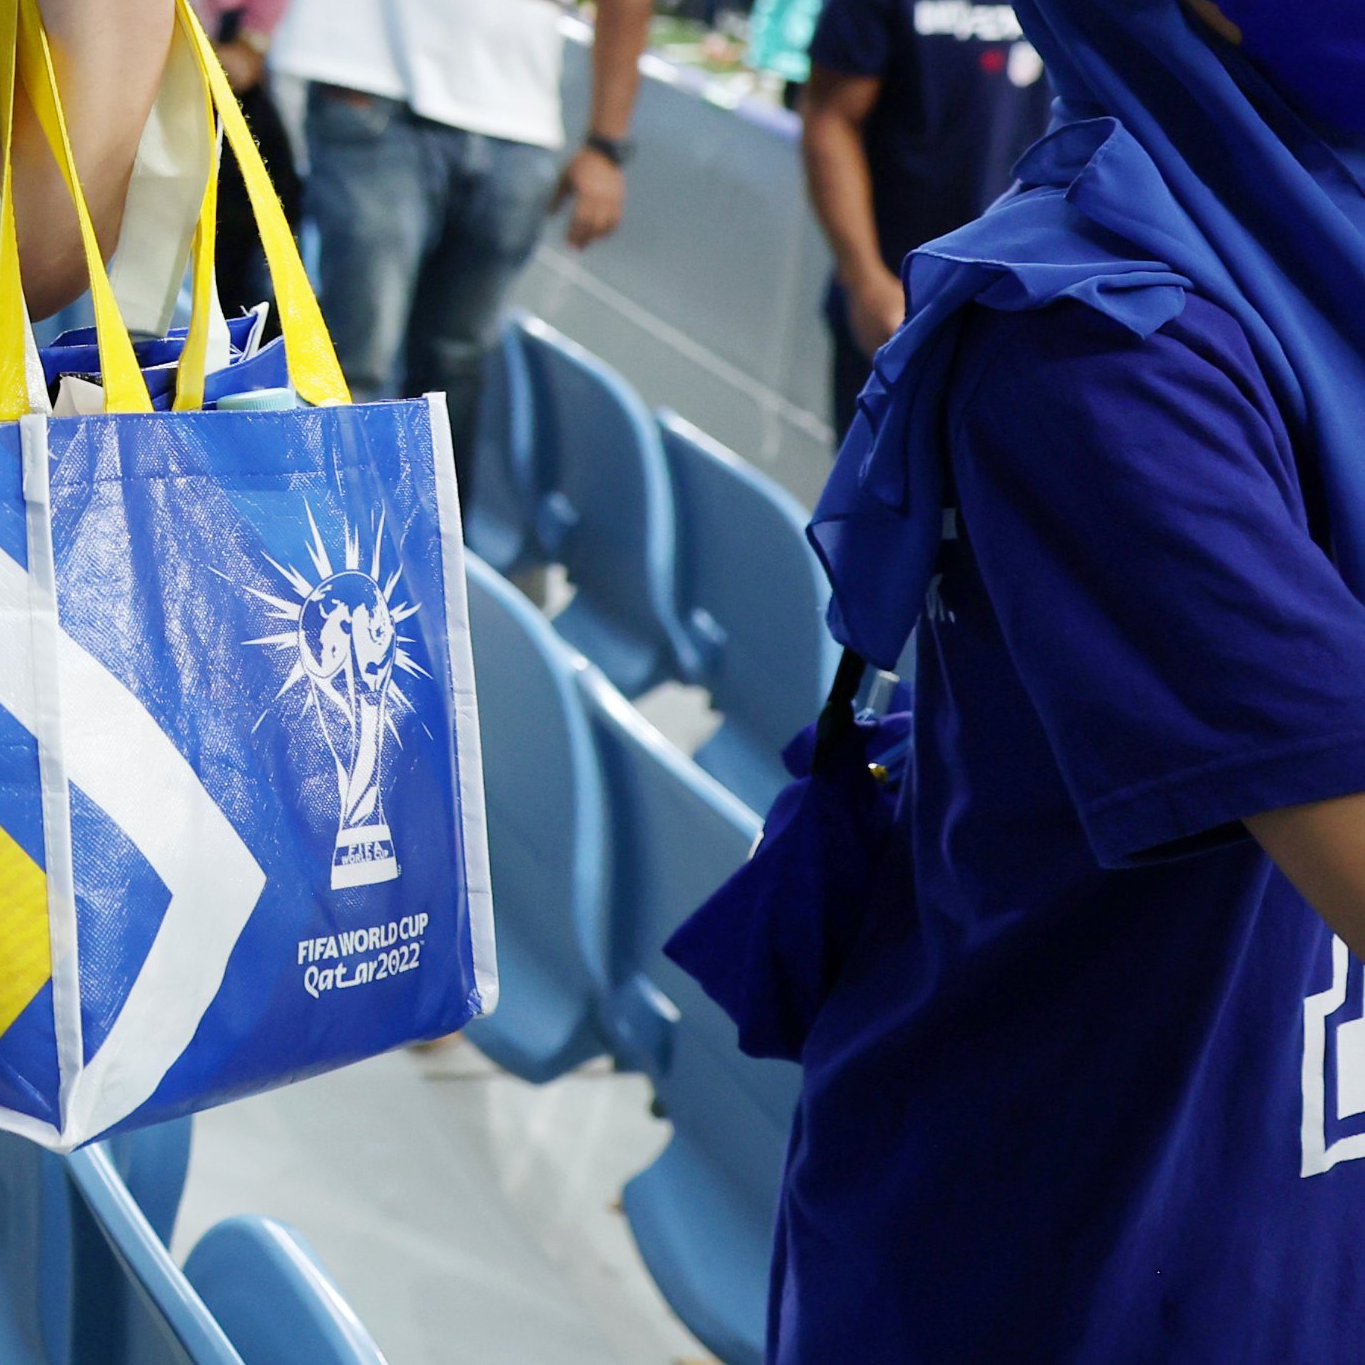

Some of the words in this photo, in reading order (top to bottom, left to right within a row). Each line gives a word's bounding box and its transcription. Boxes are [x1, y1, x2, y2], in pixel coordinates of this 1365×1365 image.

[348, 841, 383, 856] FIFA
[341, 852, 372, 865] WORLD
[374, 849, 389, 860] CUP
[298, 936, 339, 965] FIFA
[338, 922, 397, 956] WORLD
[399, 912, 429, 940] CUP
